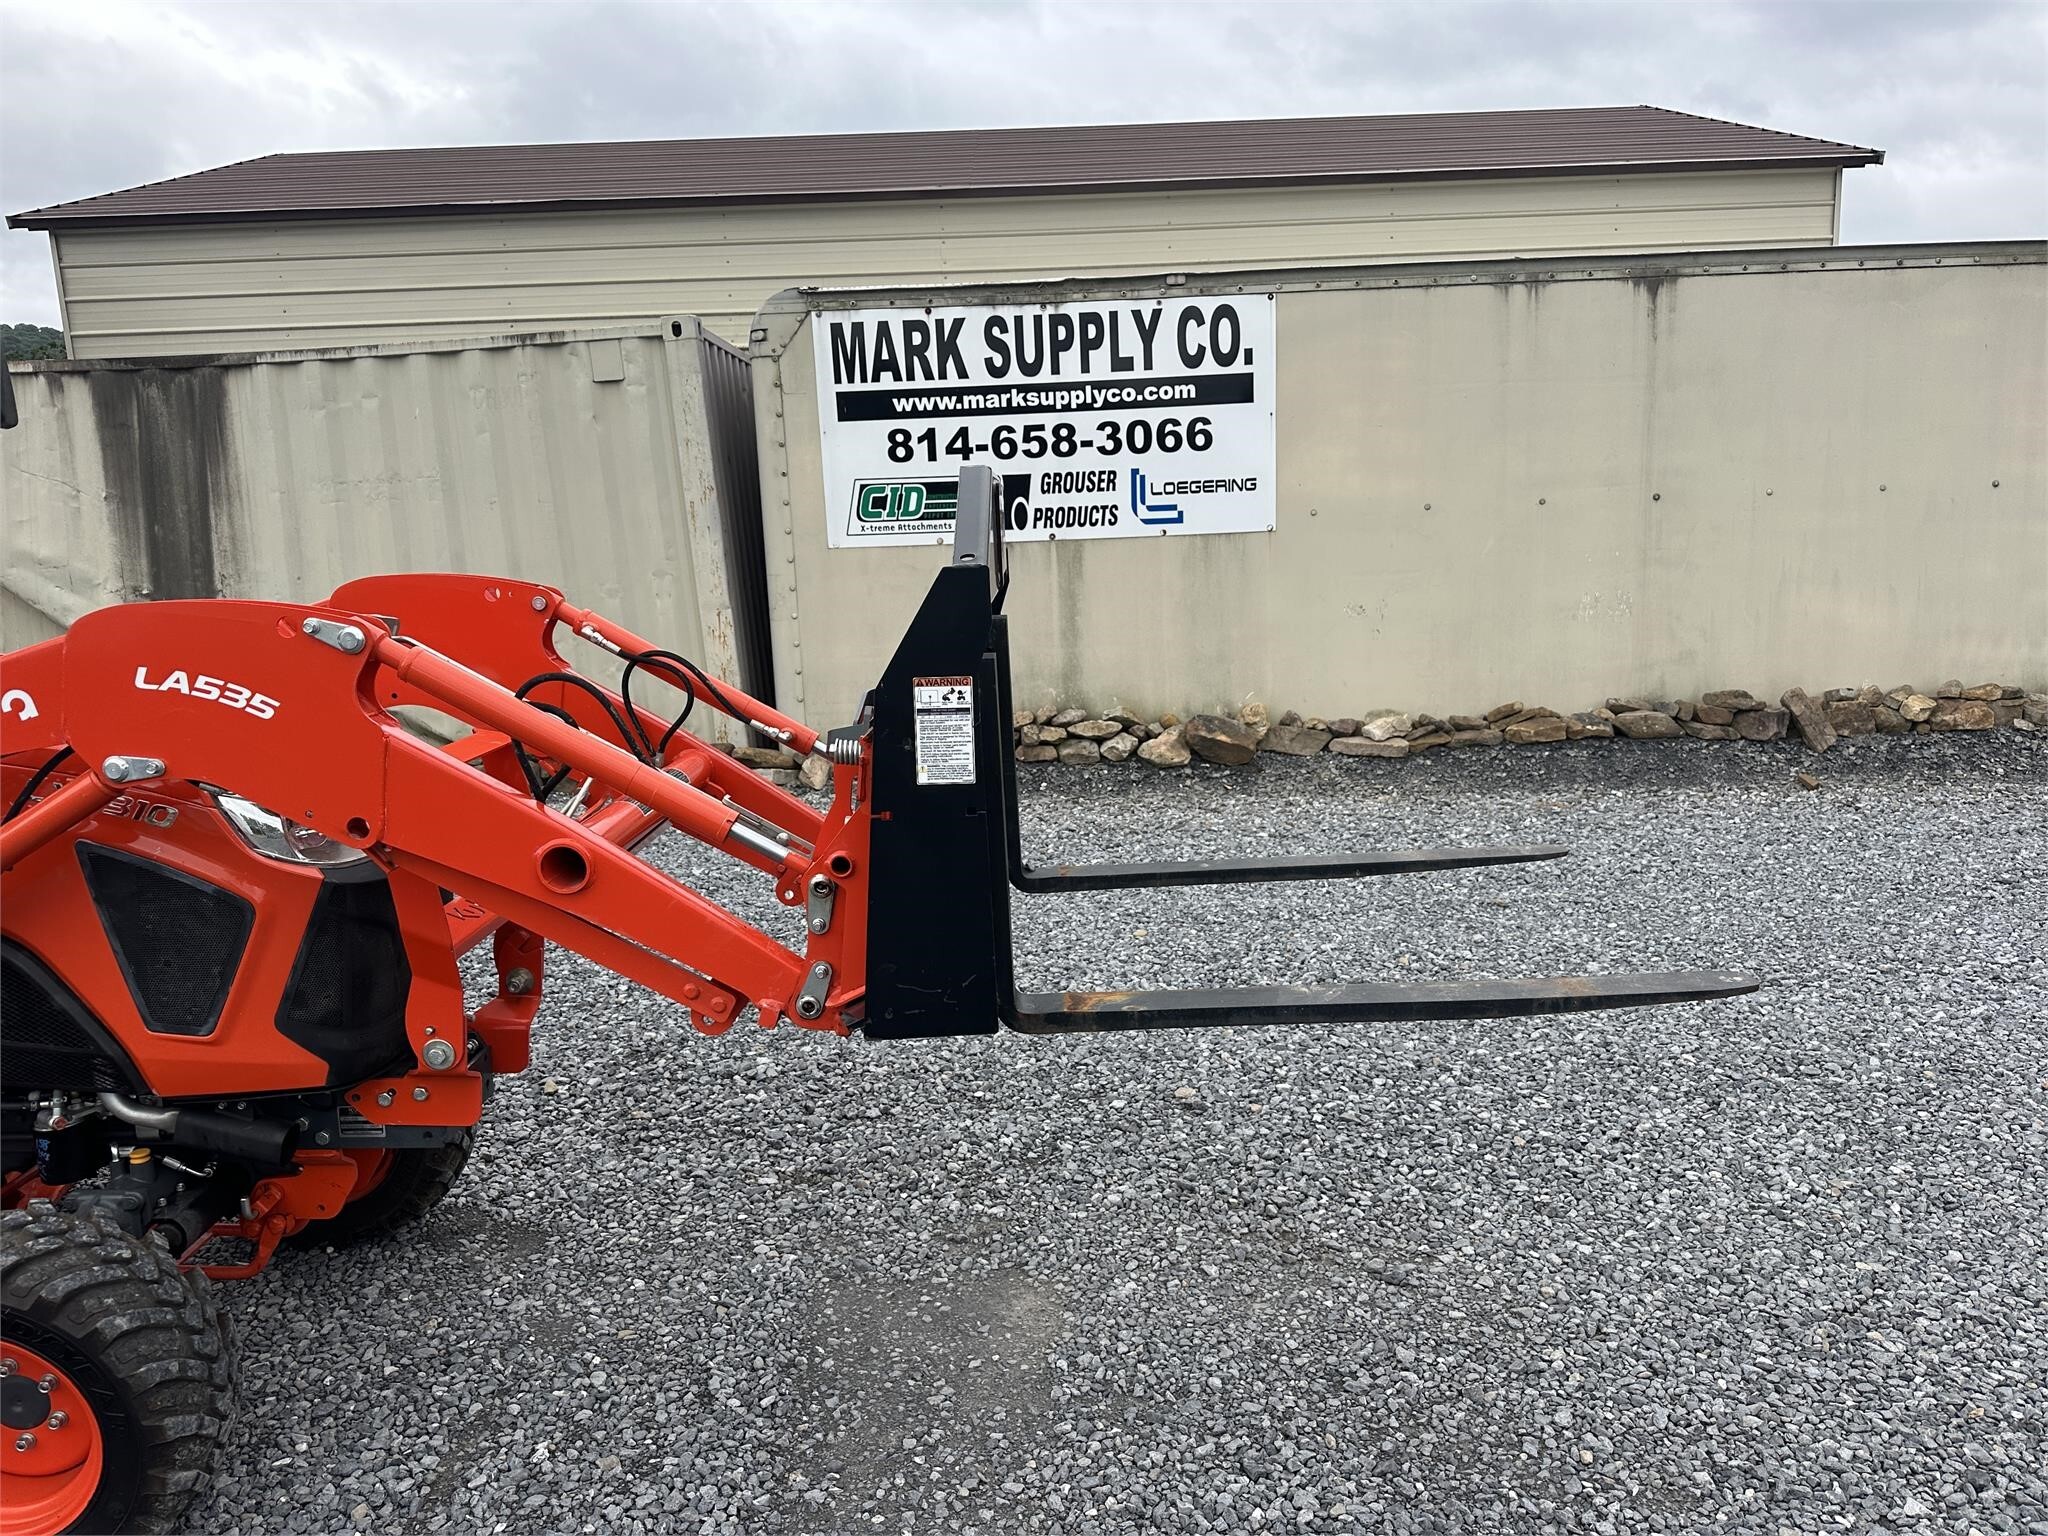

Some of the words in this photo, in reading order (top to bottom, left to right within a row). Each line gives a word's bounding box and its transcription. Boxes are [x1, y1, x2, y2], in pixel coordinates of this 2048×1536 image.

[829, 317, 970, 385] MARK
[983, 307, 1163, 379] SUPPLY
[1177, 303, 1255, 369] CO.
[892, 382, 1197, 412] www.marksupplyco.com
[887, 416, 1214, 463] 814-658-3066
[1040, 470, 1118, 494] GROUSER
[1150, 477, 1257, 496] LOEGERING
[860, 485, 927, 520] CID
[860, 524, 896, 532] X-treme
[1033, 504, 1119, 530] PRODUCTS
[134, 666, 281, 720] LA535
[924, 678, 969, 687] WARNING
